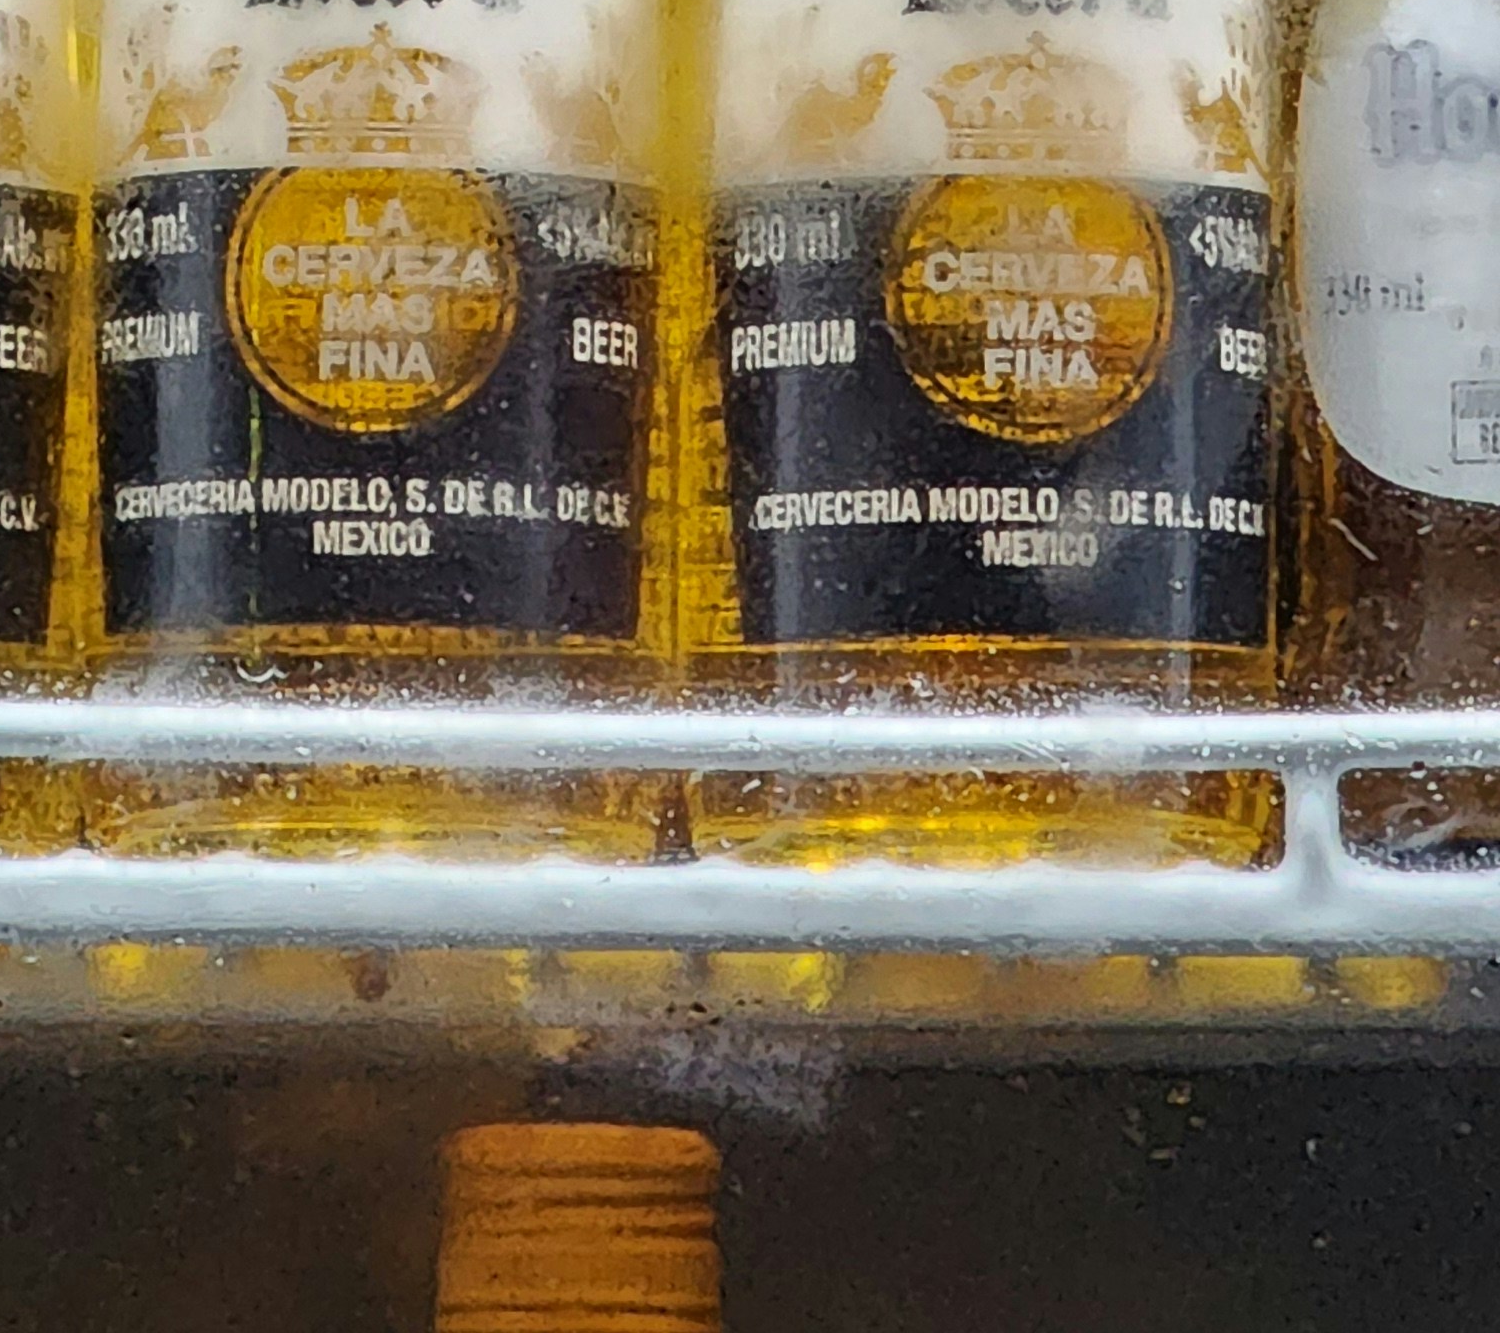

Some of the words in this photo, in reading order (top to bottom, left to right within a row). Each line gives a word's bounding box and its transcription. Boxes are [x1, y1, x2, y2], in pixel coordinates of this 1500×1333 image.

[344, 198, 411, 238] LA
[1006, 204, 1074, 246] LA
[262, 245, 497, 287] CERVEZA
[924, 251, 1151, 293] CERVEZA
[322, 293, 435, 333] MAS
[984, 300, 1097, 343] MAS
[318, 340, 436, 383] FINA
[573, 317, 638, 370] BEER
[731, 318, 856, 373] PREMIUM
[983, 348, 1100, 390] FINA
[115, 478, 255, 521] CERVECERIA
[261, 477, 398, 518] MODELO,
[406, 477, 437, 513] S.
[443, 479, 488, 517] DE
[557, 484, 590, 524] DE
[754, 487, 922, 532] CERVECERIA
[1110, 490, 1149, 526] DE
[1209, 496, 1236, 532] DE
[312, 518, 435, 556] MEXICO
[982, 529, 1100, 568] MEXICO
